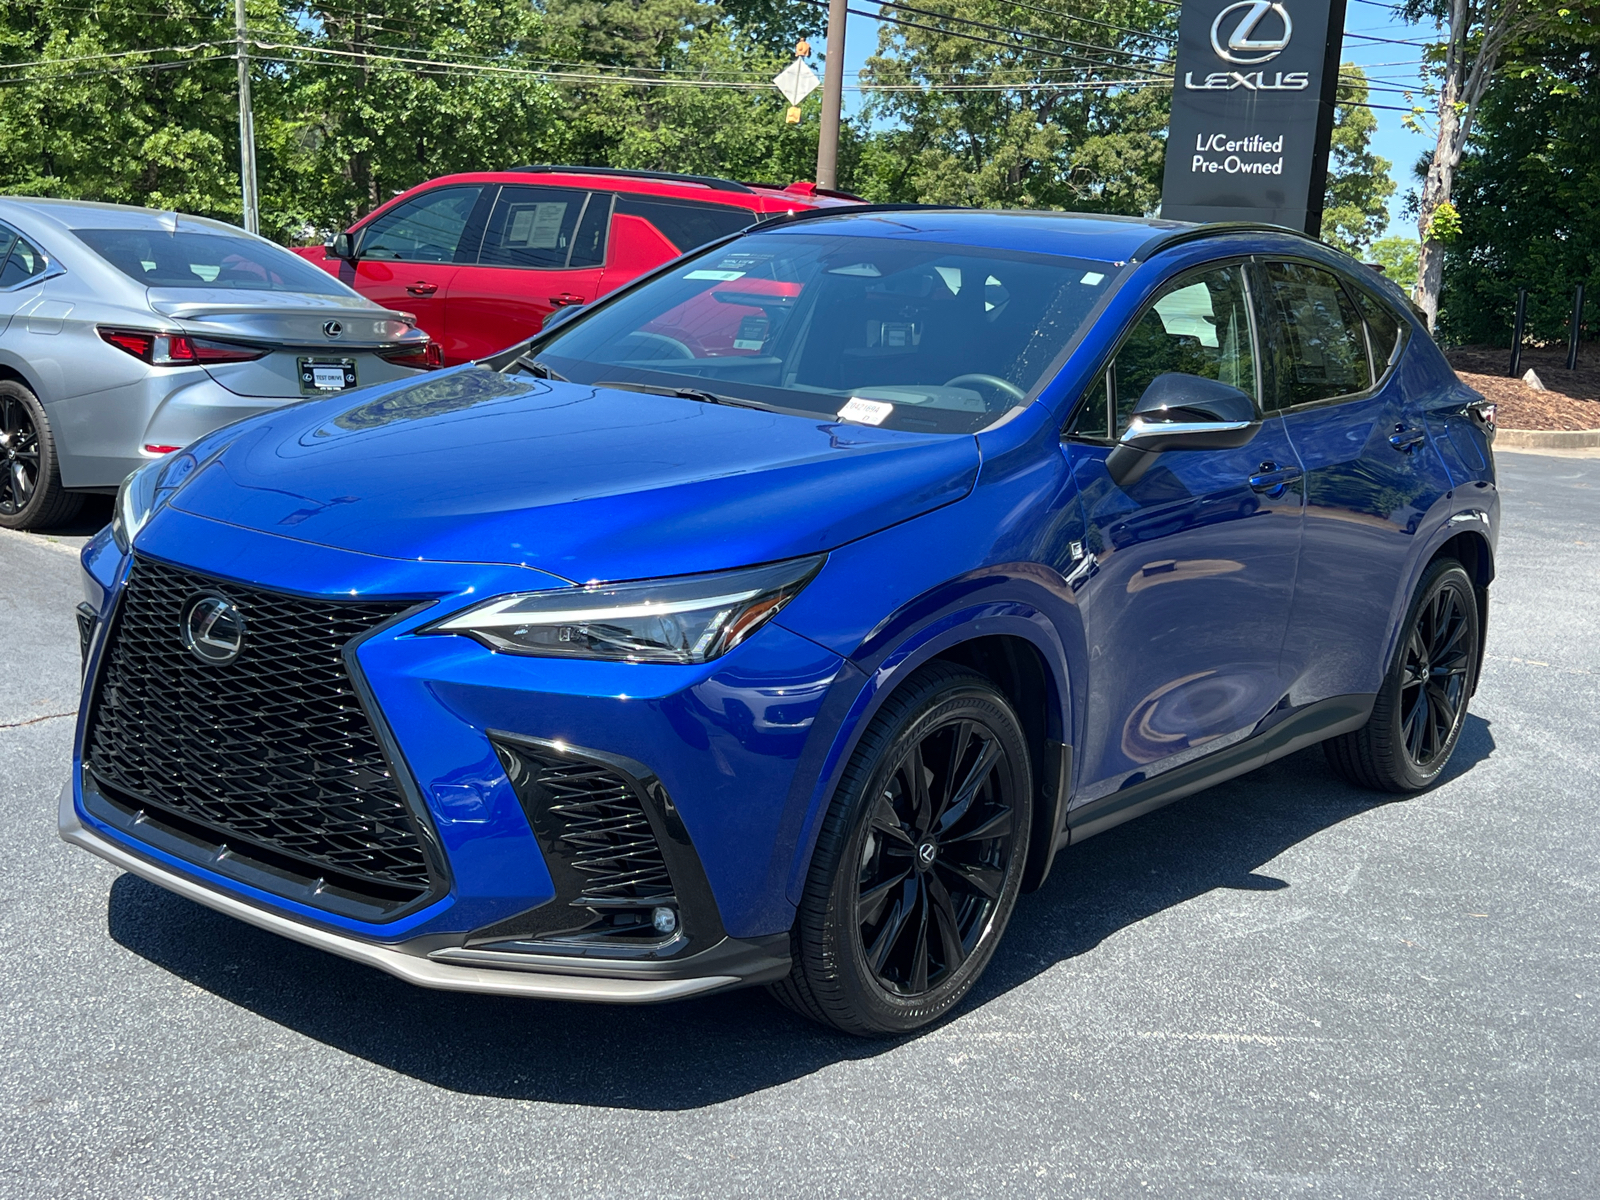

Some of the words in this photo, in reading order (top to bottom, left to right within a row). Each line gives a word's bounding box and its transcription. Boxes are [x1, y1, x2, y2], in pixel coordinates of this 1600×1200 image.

[1185, 71, 1309, 90] LEXUS
[1196, 133, 1284, 153] L/Certified
[1191, 155, 1283, 175] Pre-Owned
